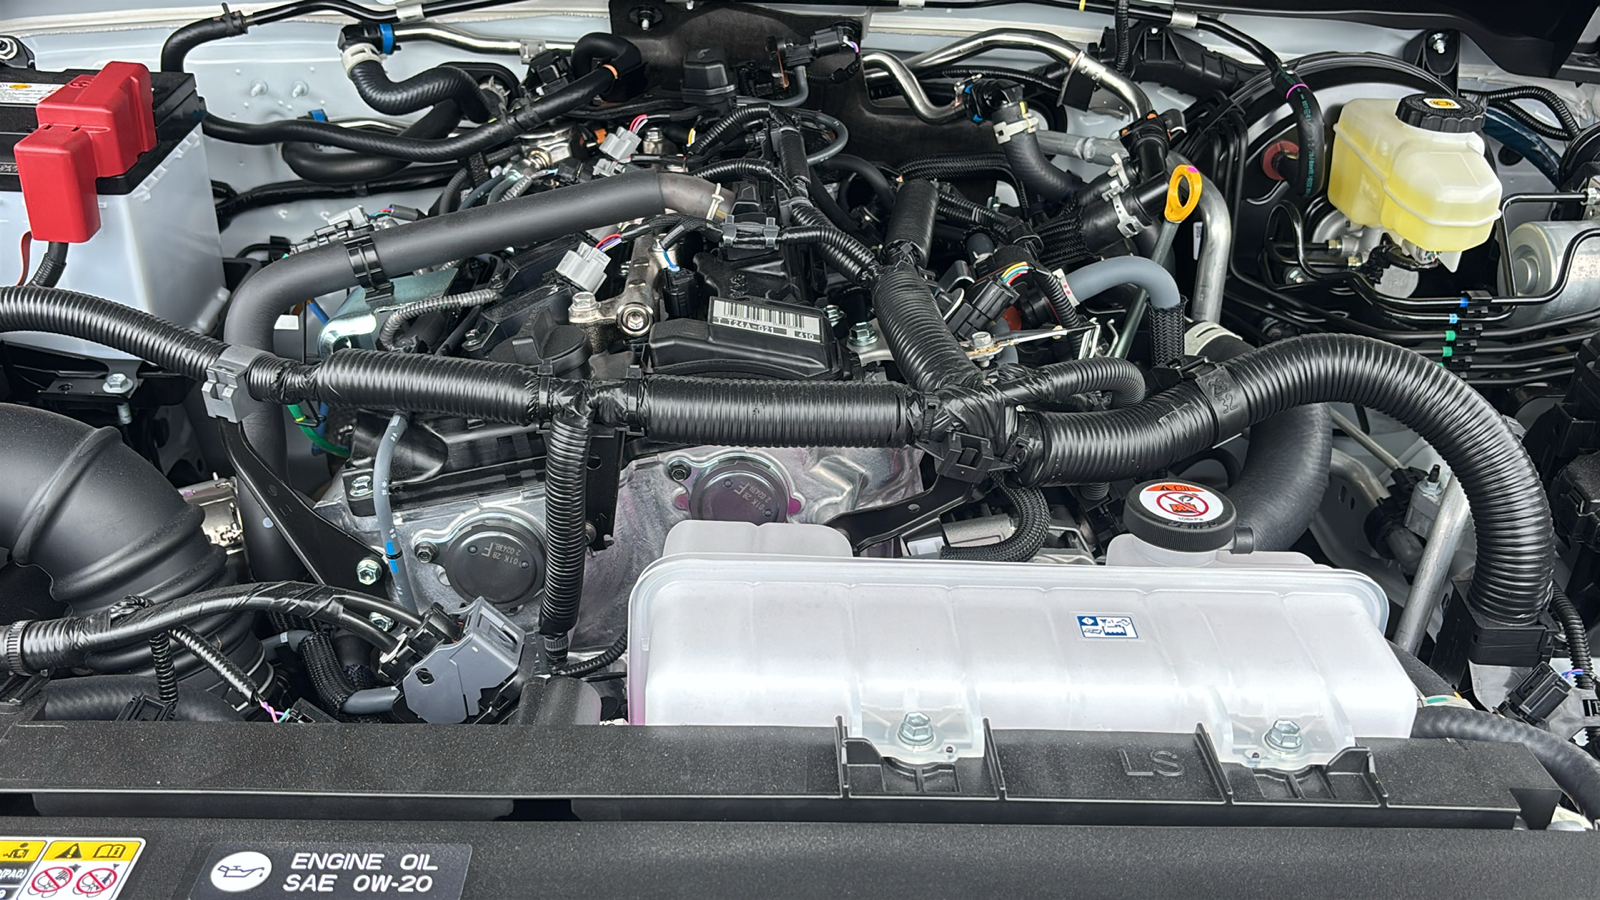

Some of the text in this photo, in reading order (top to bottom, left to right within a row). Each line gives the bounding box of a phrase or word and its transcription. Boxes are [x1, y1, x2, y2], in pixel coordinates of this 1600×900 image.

[1216, 392, 1239, 414] 32
[1117, 748, 1185, 777] LS
[290, 852, 438, 871] ENGINE OIL
[282, 873, 433, 893] SAE 0W-20
